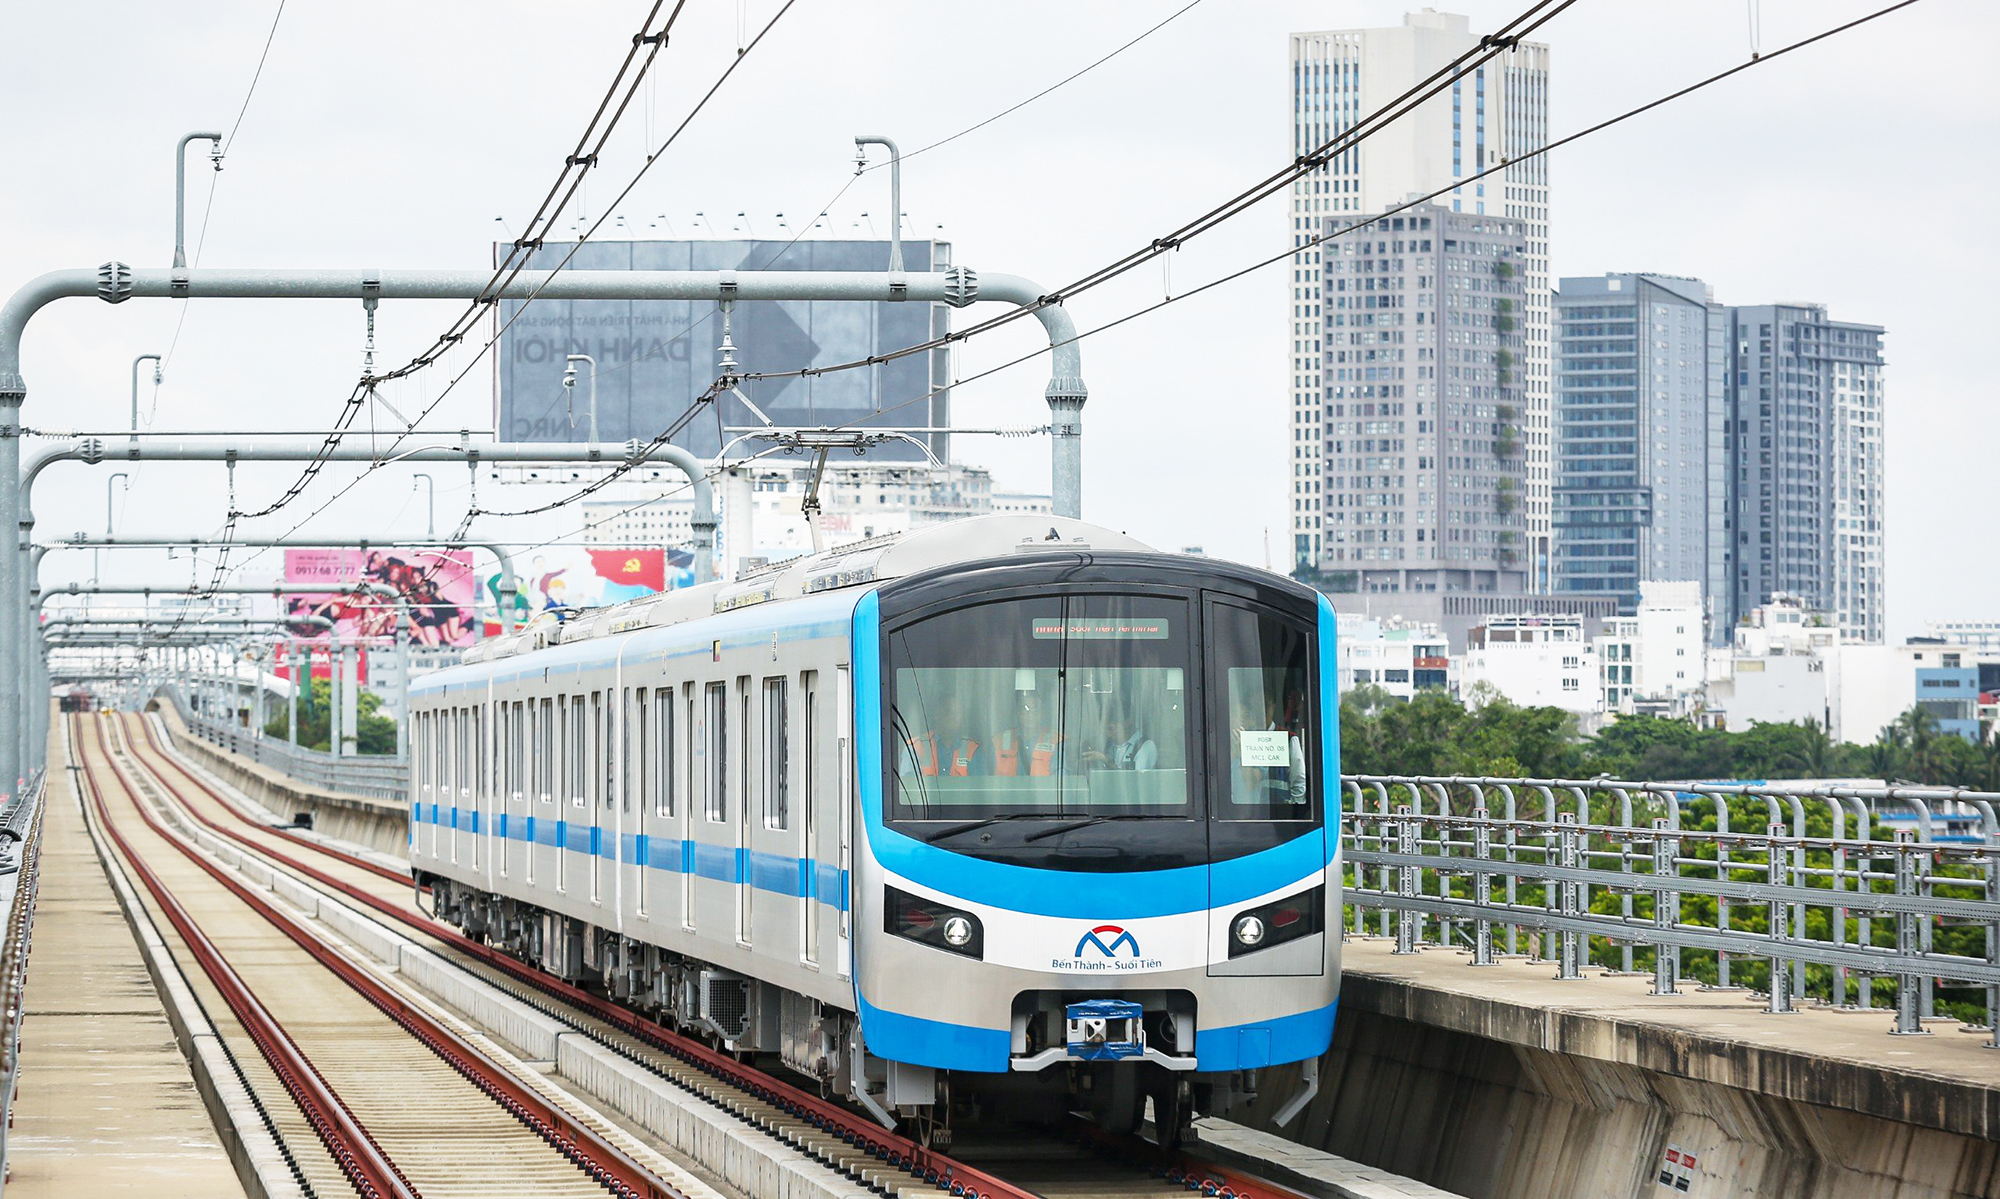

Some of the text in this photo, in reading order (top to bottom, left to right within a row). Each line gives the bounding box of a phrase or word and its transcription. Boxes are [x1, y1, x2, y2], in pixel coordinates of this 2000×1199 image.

[295, 566, 318, 575] 0917
[320, 566, 331, 575] 68
[1052, 959, 1072, 969] Bến
[1073, 960, 1106, 970] Thành
[1114, 959, 1138, 970] Suối
[1139, 958, 1162, 968] Tiên
